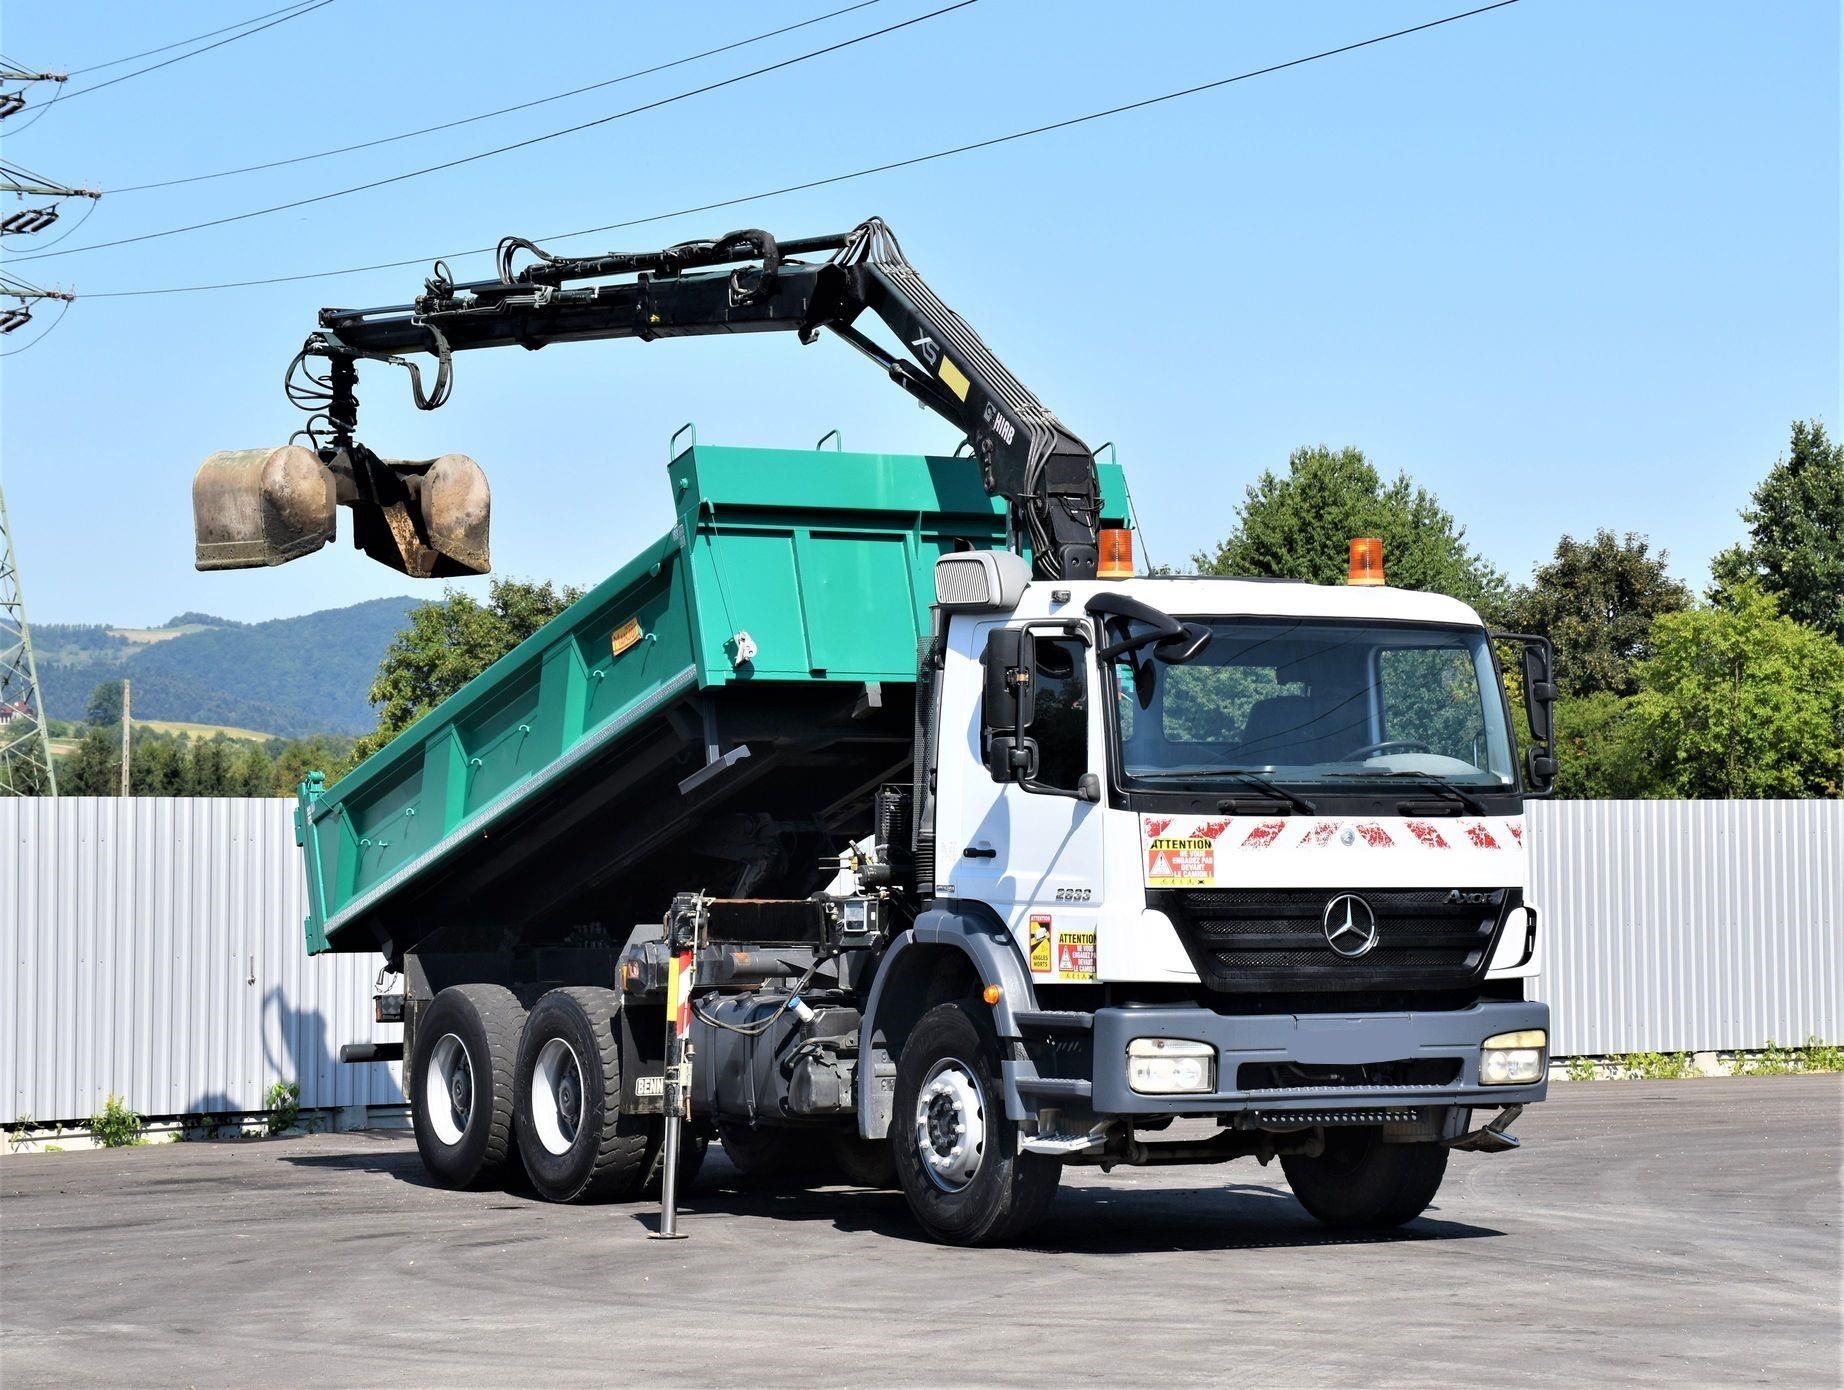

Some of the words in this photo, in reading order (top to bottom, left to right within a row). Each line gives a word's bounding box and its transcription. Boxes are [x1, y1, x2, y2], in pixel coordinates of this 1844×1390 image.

[993, 412, 1015, 445] HIAB
[1150, 839, 1212, 849] ATTENTION
[1056, 888, 1091, 901] 2833
